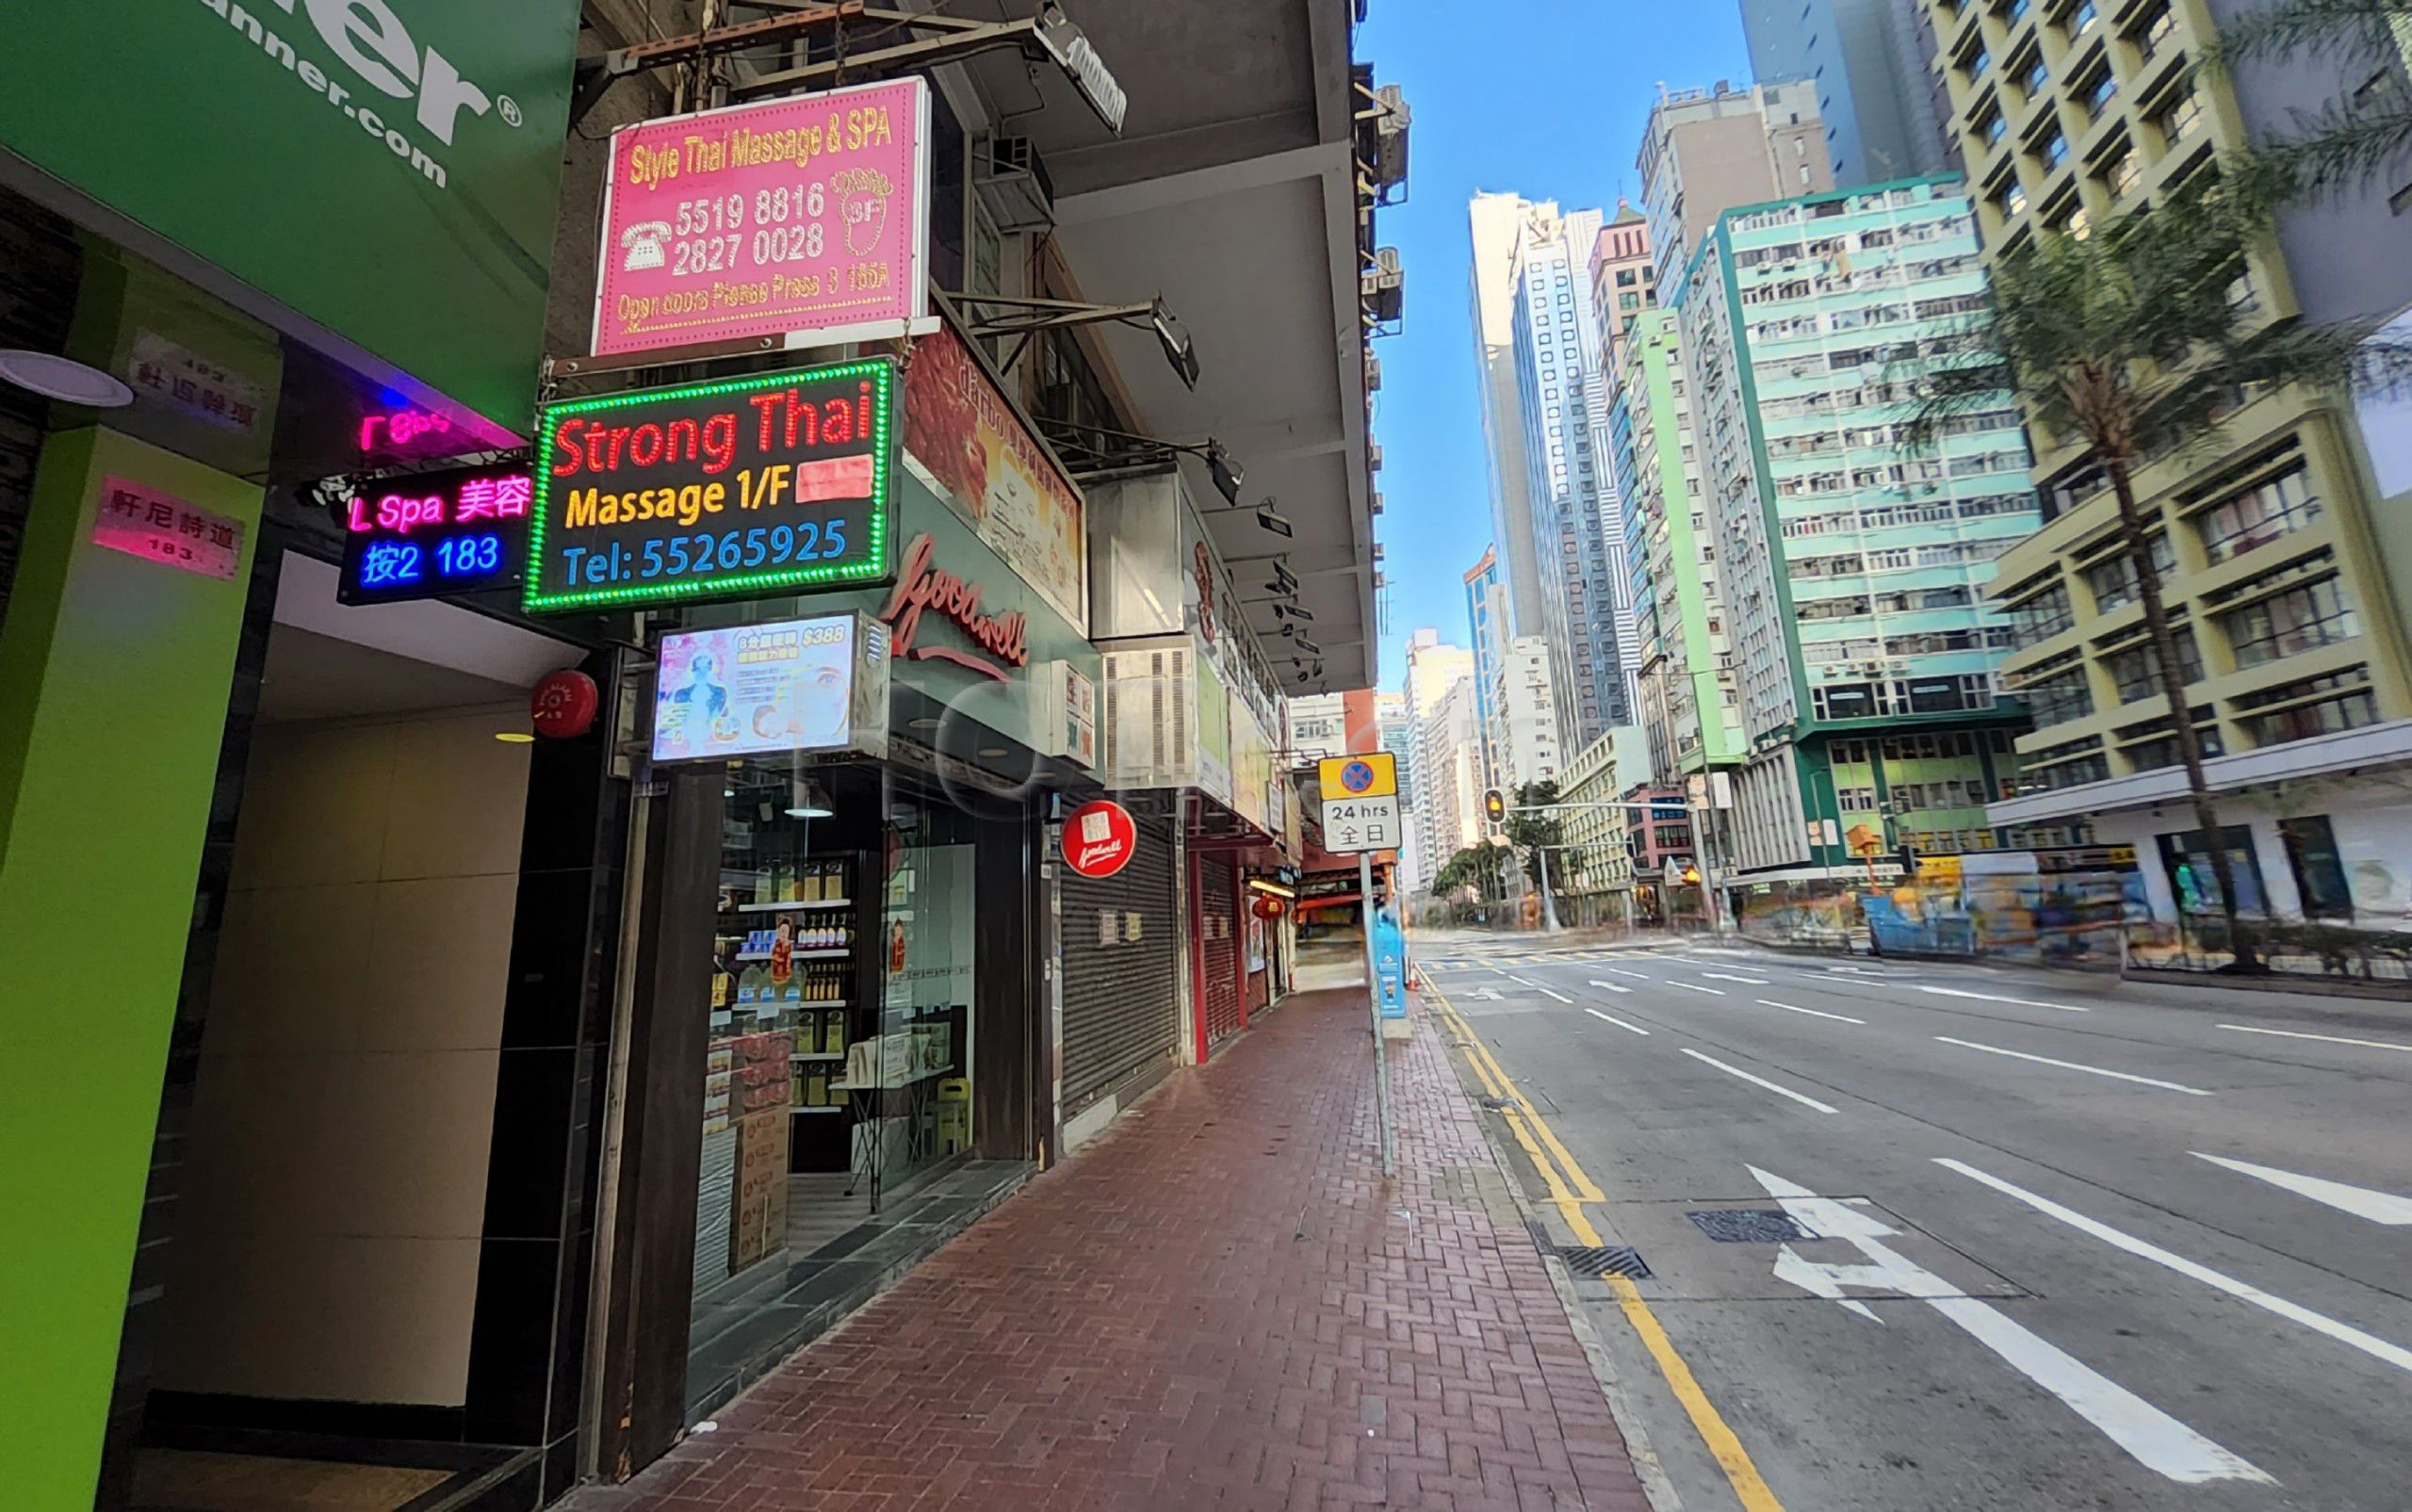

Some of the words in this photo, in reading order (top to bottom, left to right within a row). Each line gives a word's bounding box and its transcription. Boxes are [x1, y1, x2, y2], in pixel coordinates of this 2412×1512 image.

[273, 0, 491, 146] er
[685, 130, 726, 173] Thai
[731, 125, 822, 168] Massage
[826, 113, 842, 153] &
[847, 106, 892, 150] SPA
[676, 194, 743, 236] 5519
[755, 182, 824, 224] 8816
[672, 234, 742, 276] 2827
[753, 222, 823, 265] 0028
[553, 414, 738, 477] Strong
[750, 381, 872, 453] Thai
[109, 489, 236, 550] 軒尼詩道
[350, 496, 373, 531] L
[378, 495, 443, 533] Spa
[455, 475, 532, 523] 美容
[565, 482, 725, 528] Massage
[736, 464, 790, 510] 1/F
[148, 538, 193, 561] 183
[438, 536, 498, 573] 183
[642, 519, 847, 578] 55265925
[802, 626, 845, 648] $388
[1332, 805, 1355, 821] 24
[1361, 804, 1389, 818] hrs
[1340, 825, 1383, 845] 全日
